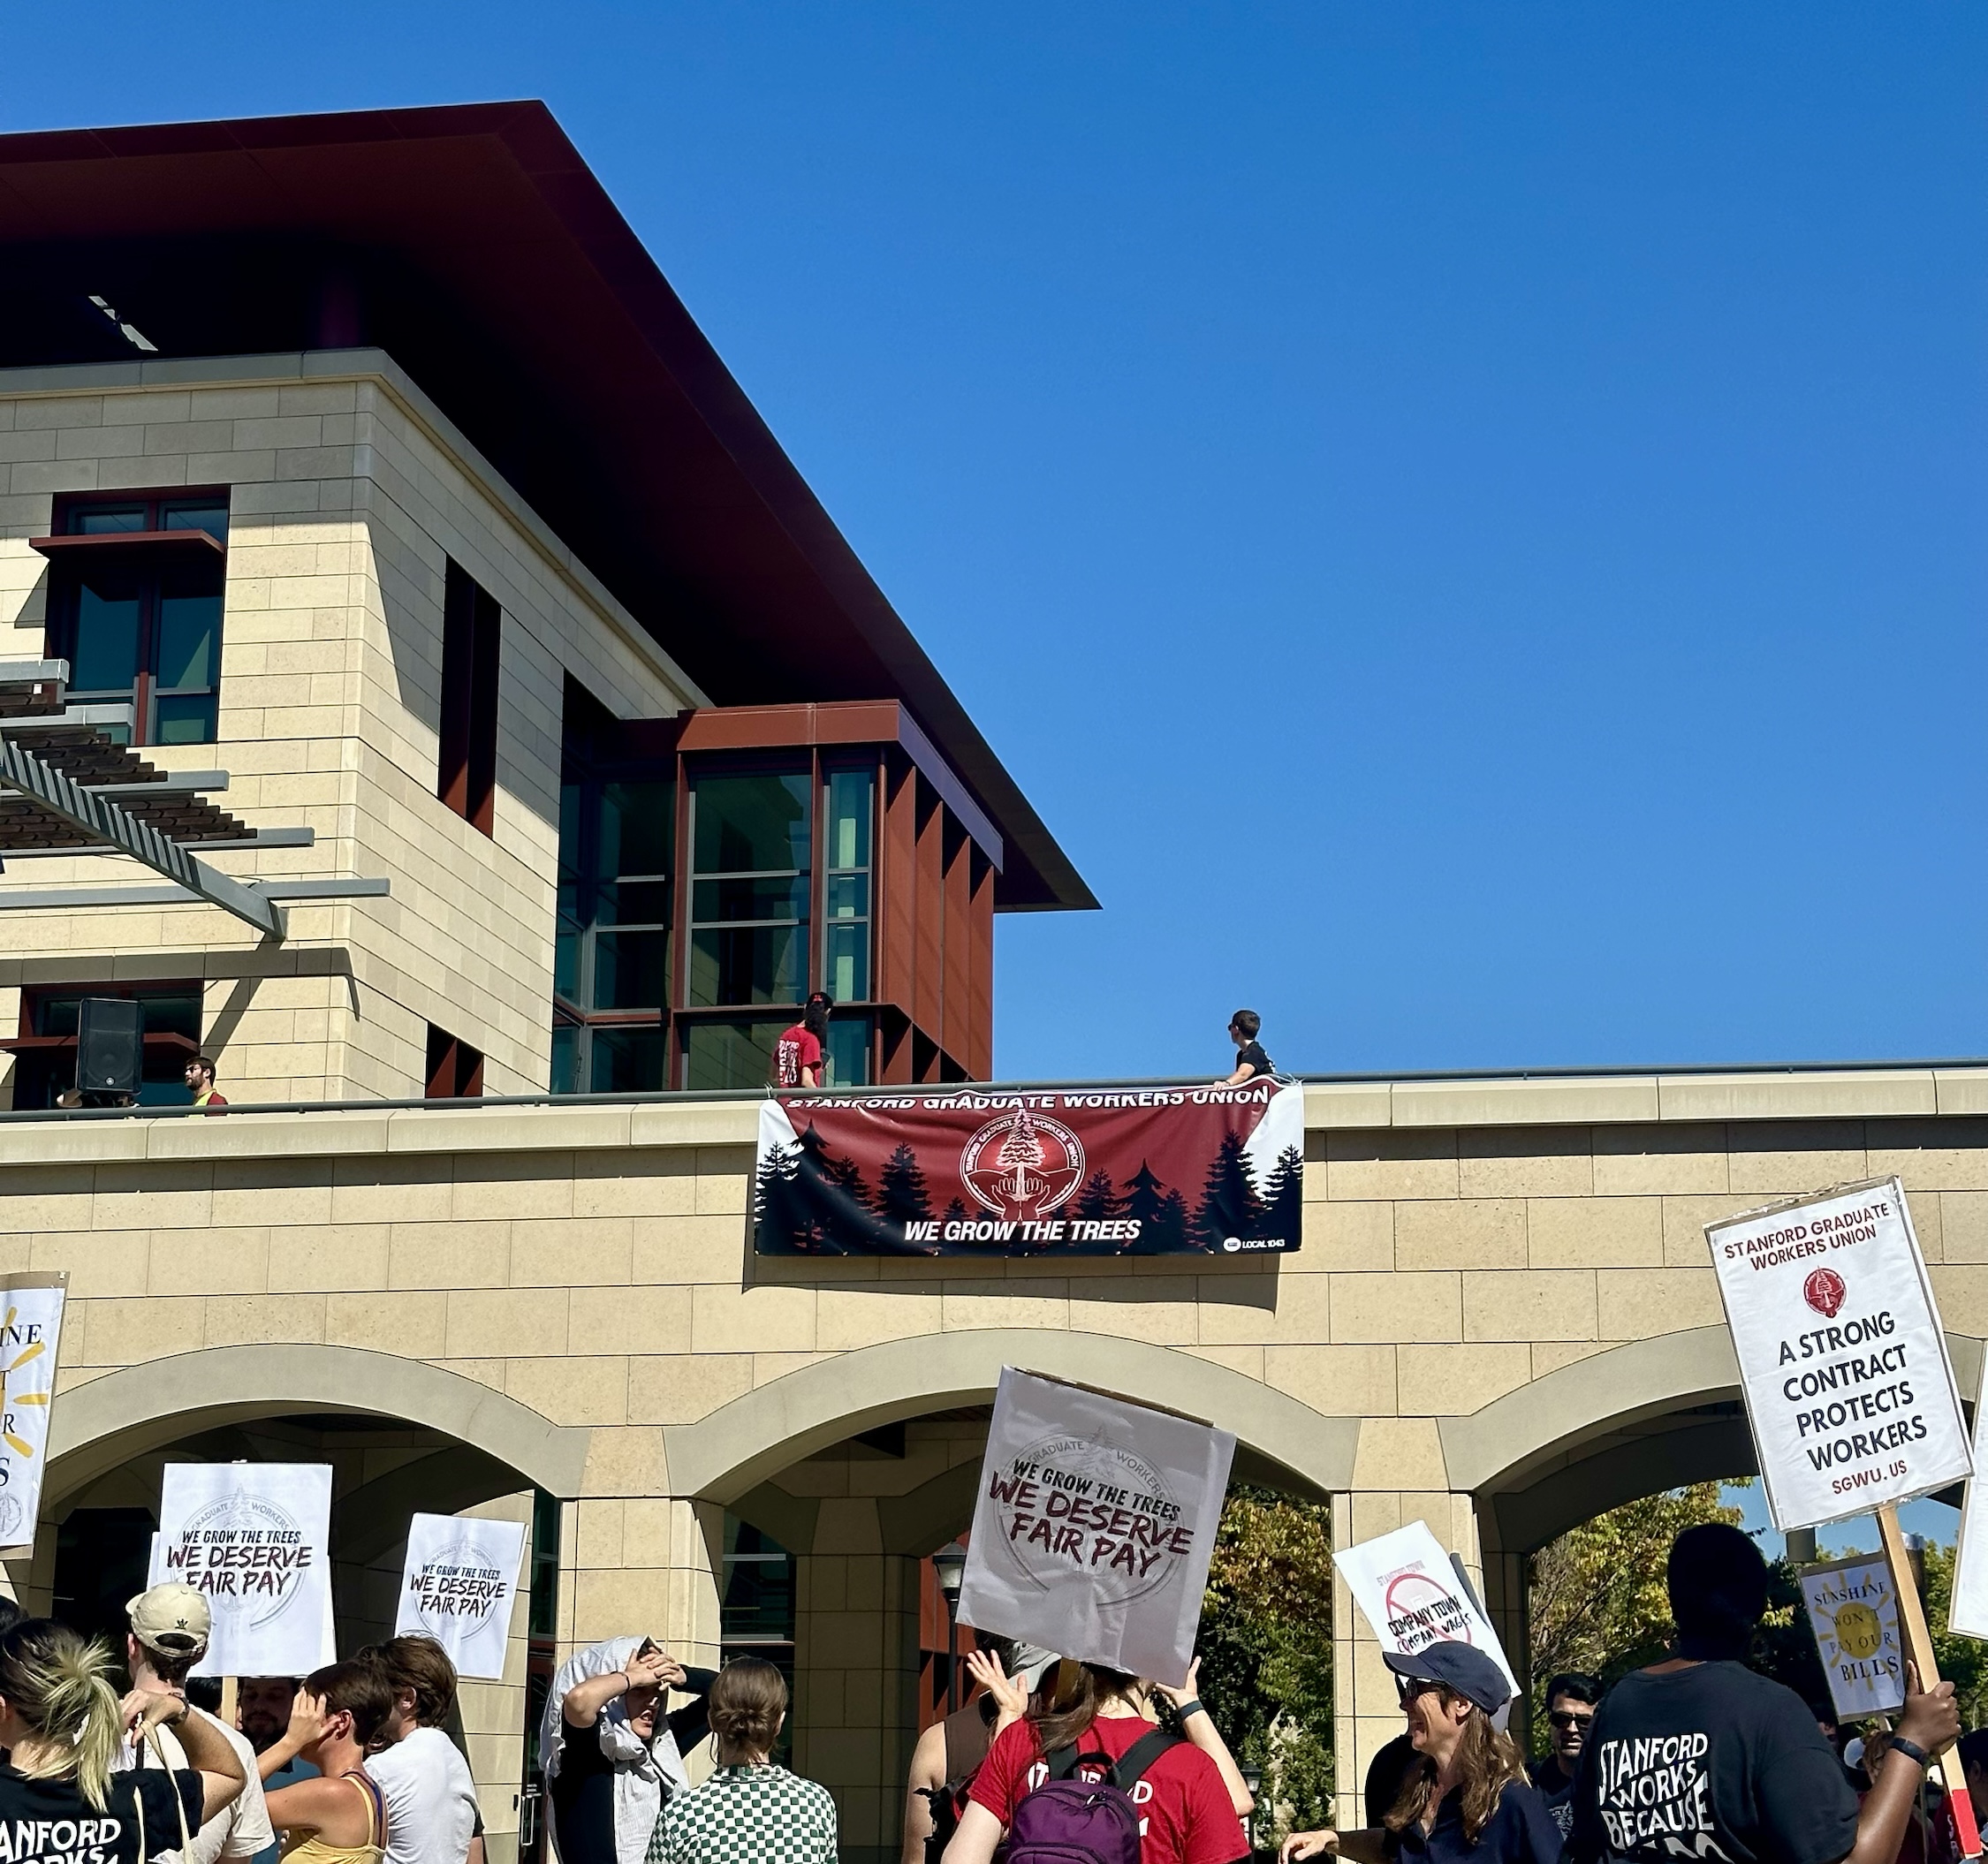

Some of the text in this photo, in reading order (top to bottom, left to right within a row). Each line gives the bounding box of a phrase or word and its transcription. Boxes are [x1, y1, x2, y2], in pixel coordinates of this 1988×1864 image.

[922, 1095, 1055, 1110] GRADUATE
[1063, 1092, 1185, 1109] WORKERS
[1192, 1085, 1269, 1105] UNION
[978, 1118, 1013, 1142] GRADUATE
[1032, 1118, 1070, 1142] WORKERS
[1066, 1141, 1080, 1167] UNION
[905, 1219, 1142, 1241] WE GROW THE TREES
[1241, 1239, 1267, 1249] LOCAL
[1725, 1202, 1890, 1259] STANFORD GRADUATE
[1750, 1224, 1877, 1271] WORKERS UNION
[1779, 1311, 1895, 1367] A STRONG
[1783, 1343, 1907, 1402] CONTRACT
[1796, 1381, 1914, 1437] PROTECTS
[1807, 1414, 1927, 1472] WORKERS
[1013, 1459, 1040, 1480] WE
[1042, 1467, 1094, 1496] GROW
[1096, 1483, 1129, 1506] THE
[1131, 1493, 1180, 1521] TREES
[1028, 1441, 1165, 1500] GRADUATE WORKERS
[251, 1502, 290, 1530] WORKERS
[989, 1471, 1040, 1510] WE
[1045, 1489, 1195, 1555] DESERVE
[167, 1546, 313, 1571] WE DESERVE
[182, 1530, 301, 1544] WE GROW THE TREES
[1010, 1512, 1162, 1579] FAIR PAY
[186, 1570, 292, 1597] FAIR PAY
[410, 1574, 507, 1600] WE DESERVE
[421, 1564, 501, 1580] WE GROW THE TREES
[1814, 1581, 1886, 1606] SUNSHINE
[420, 1595, 492, 1618] FAIR PAY
[1387, 1595, 1463, 1638] COMPANY TOWN
[1397, 1613, 1473, 1653] COMPANY WAGES
[1829, 1632, 1893, 1654] PAY OUR
[1840, 1656, 1899, 1681] BILLS
[1599, 1732, 1709, 1806] STANFORD
[1610, 1759, 1697, 1808] WORKS
[1600, 1769, 1715, 1851] BECAUSE
[0, 1818, 122, 1864] ANFORD
